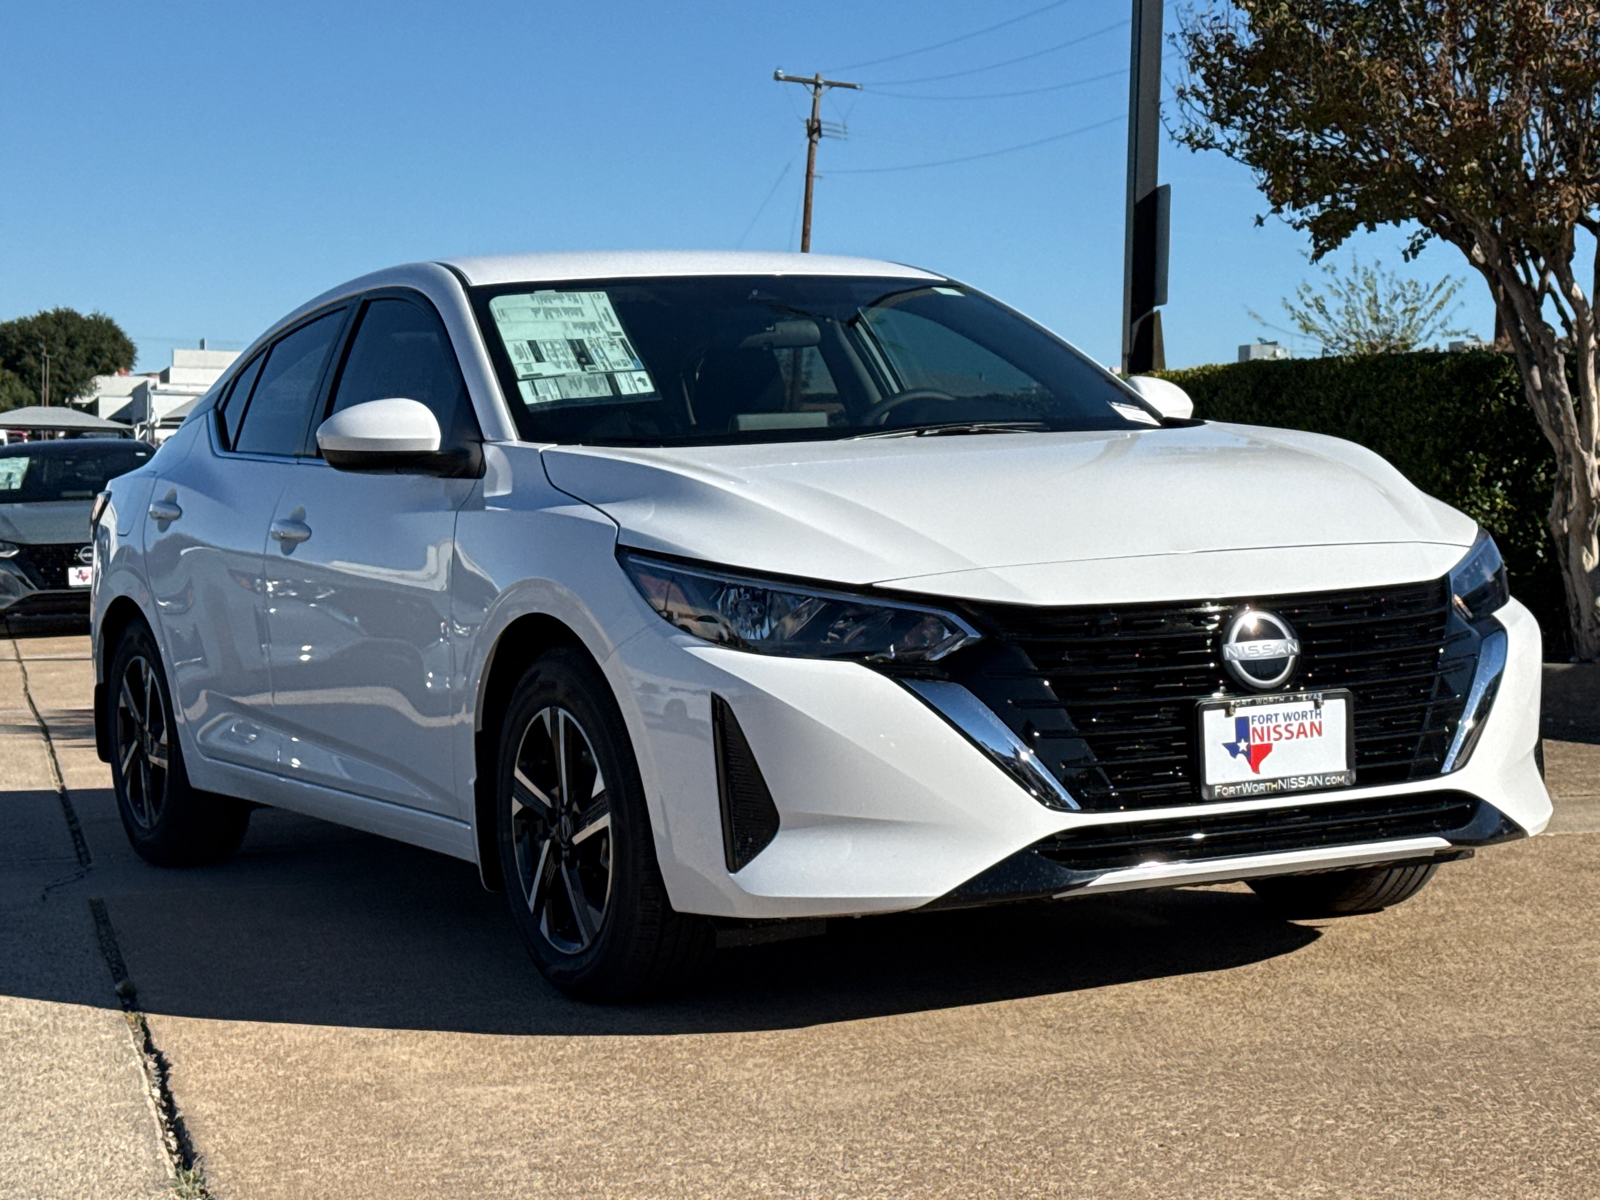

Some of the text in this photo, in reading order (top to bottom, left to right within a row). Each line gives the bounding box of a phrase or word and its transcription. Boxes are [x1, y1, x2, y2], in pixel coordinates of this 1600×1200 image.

[1225, 641, 1299, 659] NISSAN
[1255, 696, 1285, 705] WORTH
[1297, 692, 1323, 702] TEXAS
[1251, 709, 1322, 725] FORT WORTH
[1251, 721, 1323, 743] NISSAN
